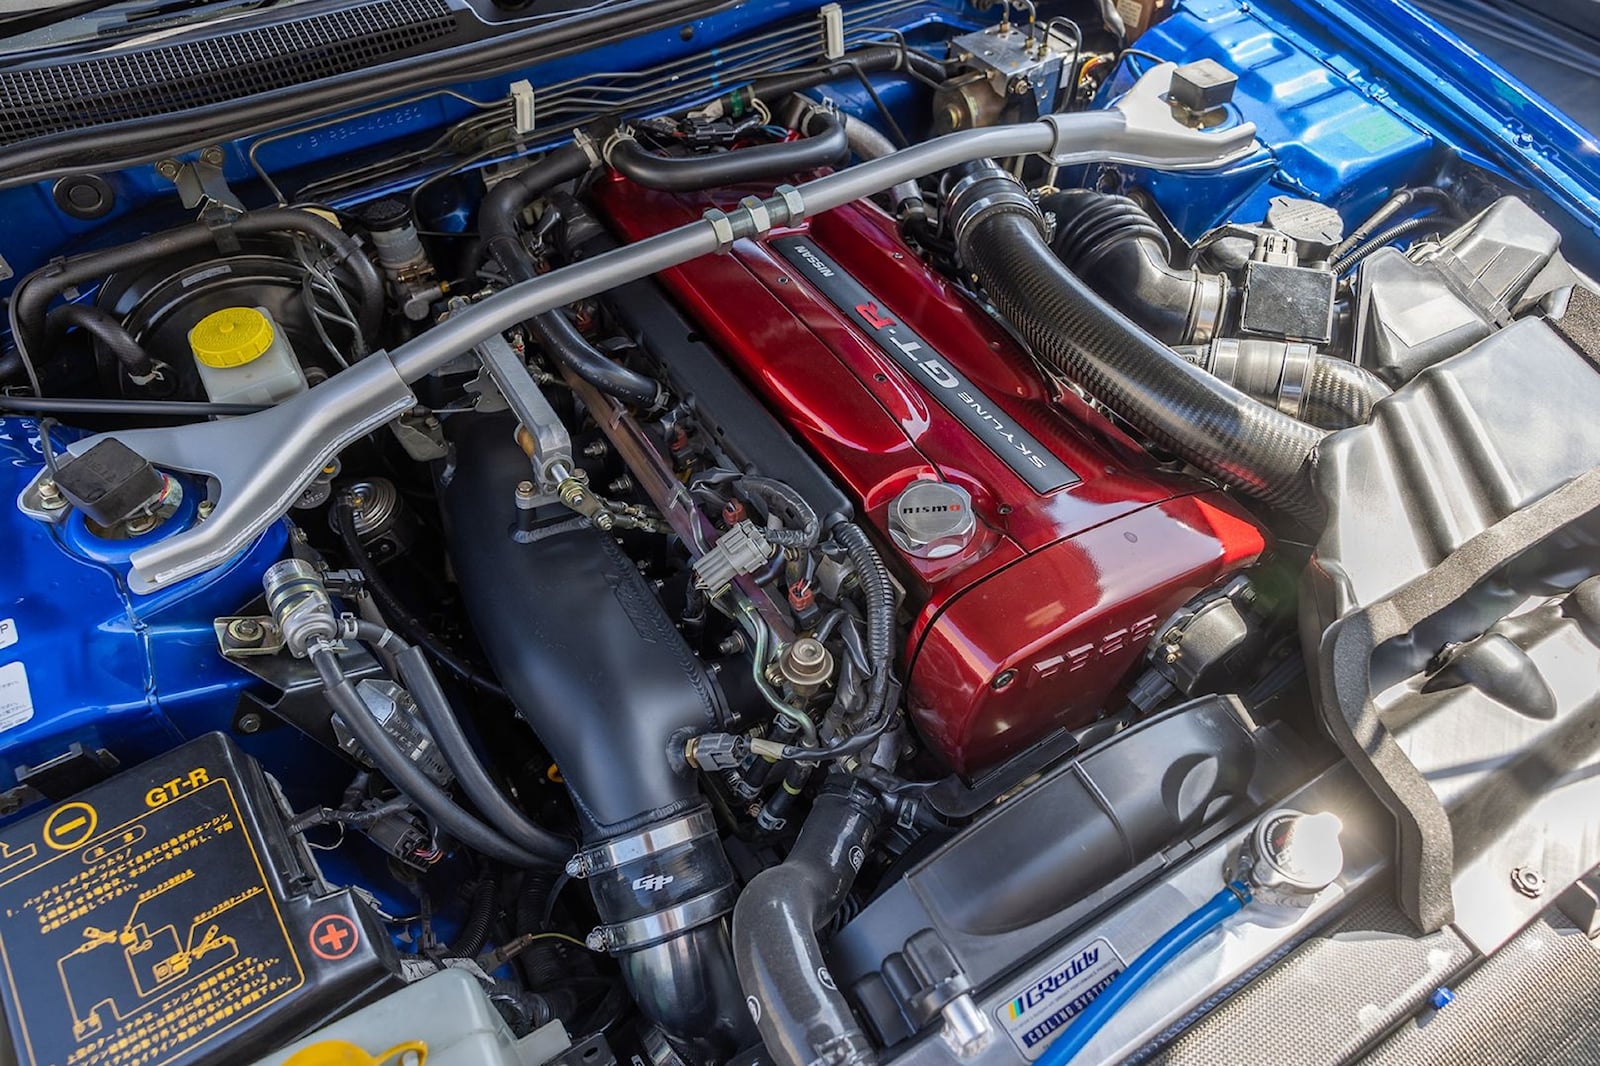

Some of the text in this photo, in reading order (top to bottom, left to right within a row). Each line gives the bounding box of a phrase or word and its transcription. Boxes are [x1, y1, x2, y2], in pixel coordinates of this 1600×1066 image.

[794, 245, 835, 277] NISSAN
[957, 391, 1047, 470] SKYLINE
[144, 767, 210, 808] GT-R
[1025, 947, 1099, 1009] GReddy
[1027, 1005, 1073, 1043] COOLING
